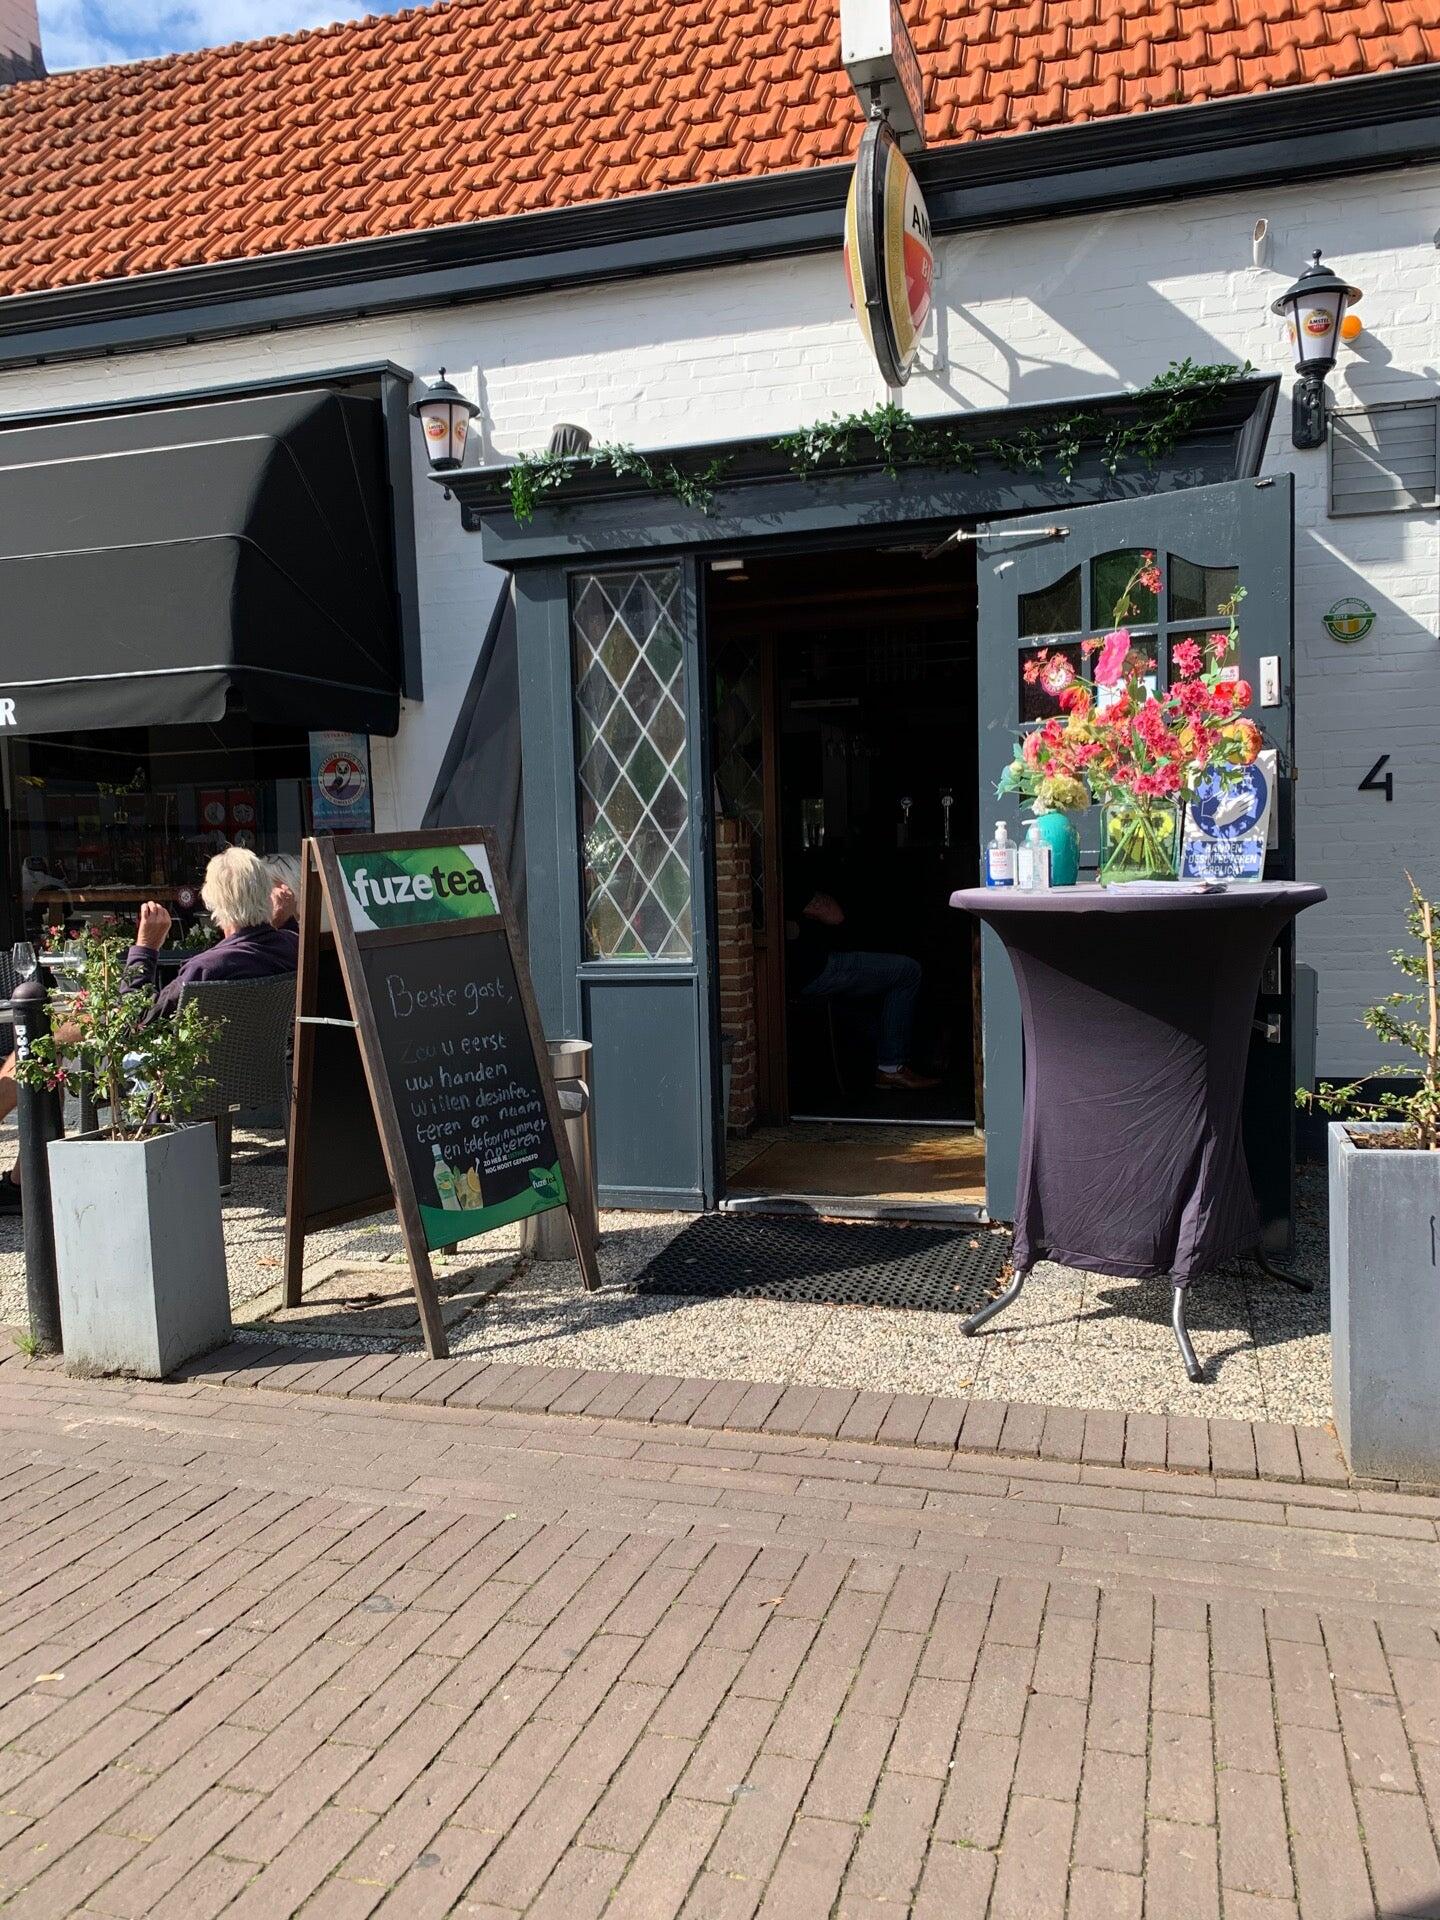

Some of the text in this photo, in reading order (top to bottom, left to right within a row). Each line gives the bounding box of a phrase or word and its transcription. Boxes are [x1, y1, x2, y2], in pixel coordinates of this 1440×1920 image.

[1358, 754, 1393, 802] 4
[1204, 842, 1243, 854] HANDEN
[1188, 853, 1257, 864] DESINFECTEREN
[1199, 865, 1245, 876] VERPLICHT
[386, 974, 513, 1018] Beste gast,
[441, 1040, 455, 1056] u
[461, 1032, 507, 1054] eerst
[405, 1062, 508, 1092] uw handen
[416, 1099, 541, 1143] teren en naam
[443, 1143, 461, 1160] en
[484, 1133, 541, 1160] noteren
[483, 1159, 491, 1167] ZO
[485, 1166, 496, 1175] NOG
[496, 1161, 513, 1170] NOOIT
